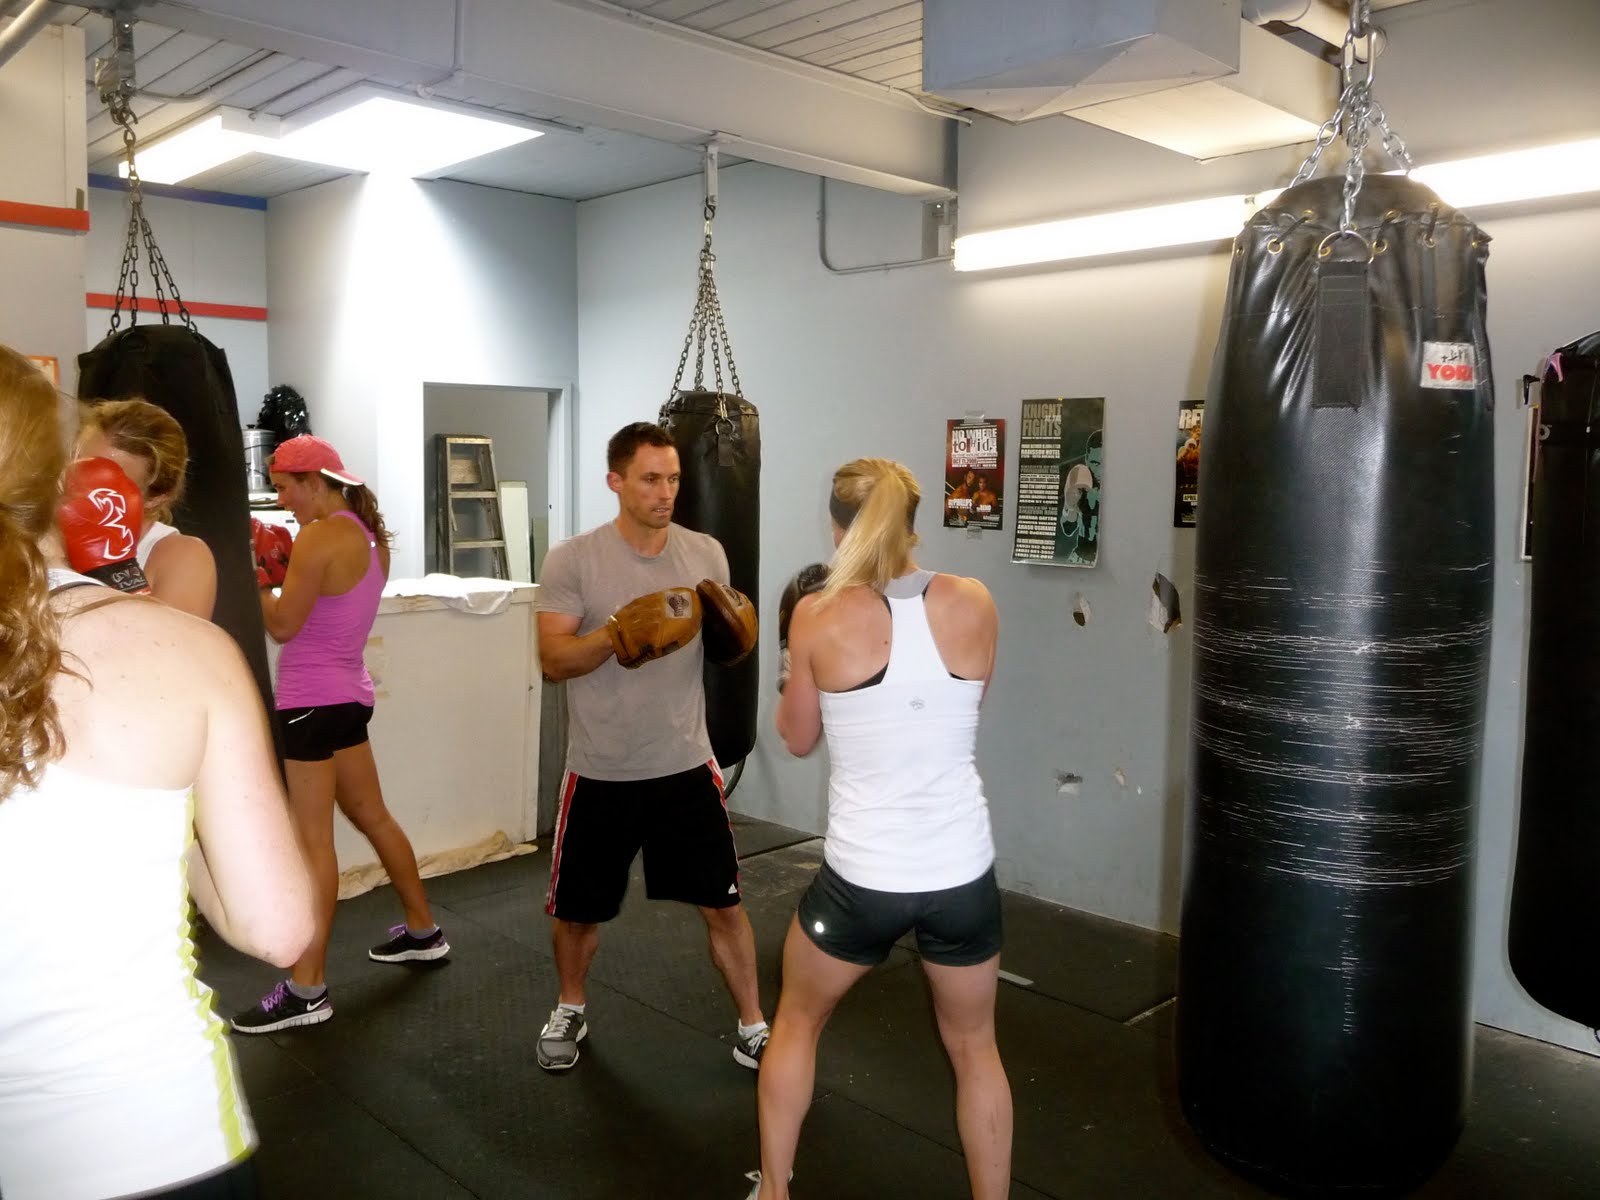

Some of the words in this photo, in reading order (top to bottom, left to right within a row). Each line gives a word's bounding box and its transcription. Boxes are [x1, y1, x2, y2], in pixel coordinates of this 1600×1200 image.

[1426, 362, 1473, 381] YOR
[1023, 403, 1062, 418] KNIGHT
[1022, 419, 1061, 436] FIGHTS
